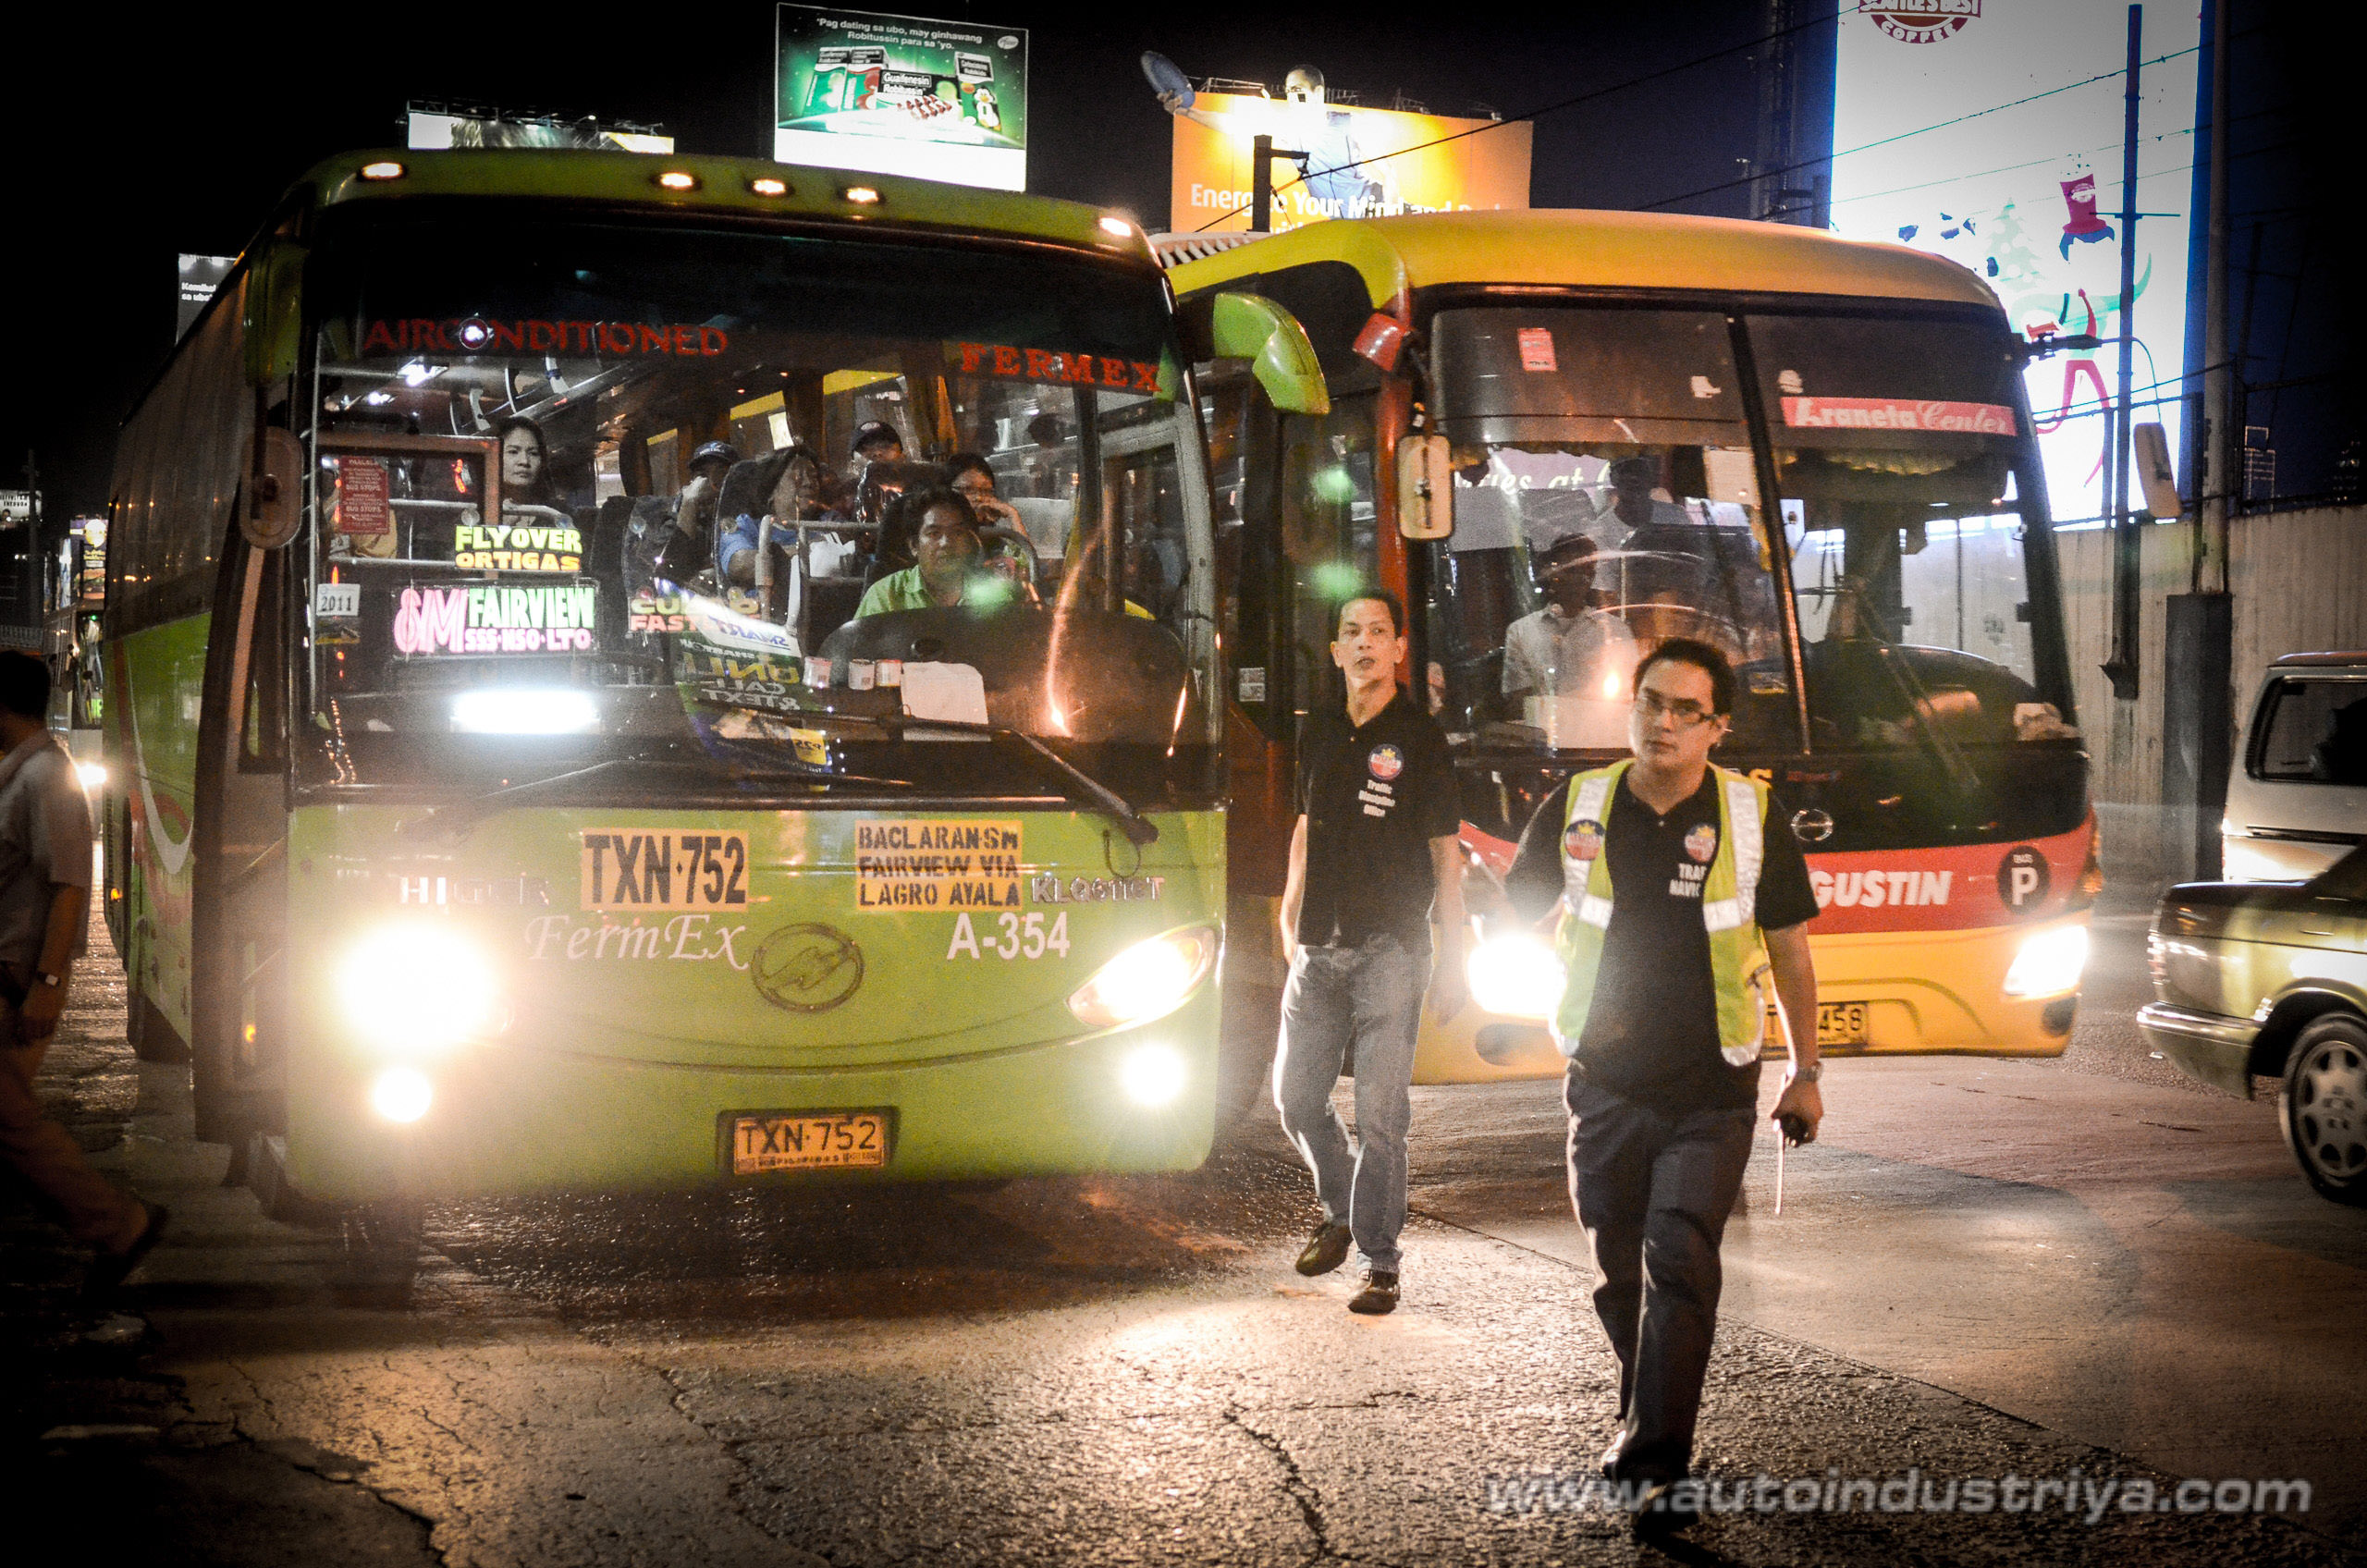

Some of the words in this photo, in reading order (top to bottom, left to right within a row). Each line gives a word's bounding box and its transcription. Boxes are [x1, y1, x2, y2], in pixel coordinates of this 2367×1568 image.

[840, 20, 871, 32] dating
[872, 24, 885, 32] sa
[909, 29, 929, 39] may
[930, 30, 983, 44] ginhawang
[847, 31, 900, 43] Robitussin
[901, 37, 923, 48] para
[1881, 20, 1957, 43] COFFEE
[884, 72, 930, 85] Guaifenesin
[1190, 183, 1288, 218] Energe
[1293, 190, 1344, 218] Your
[1347, 194, 1405, 219] Mind
[364, 319, 728, 356] AIRCNDITIONED
[958, 340, 1162, 392] FERMEX
[1794, 397, 1919, 429] Araneta
[1915, 400, 2007, 433] Center
[455, 525, 583, 554] FLYOVER
[455, 551, 582, 571] ORTIGAS
[319, 595, 351, 612] 2011
[469, 587, 595, 629] FAIRVIEW
[858, 855, 971, 877] FAIRVIEW
[979, 855, 1019, 877] VIA
[2012, 853, 2034, 864] BUS
[859, 882, 938, 906] LAGRO
[949, 881, 1021, 906] AYALA
[2010, 865, 2040, 907] P
[524, 913, 750, 971] FermEx
[947, 911, 1071, 960] A-354
